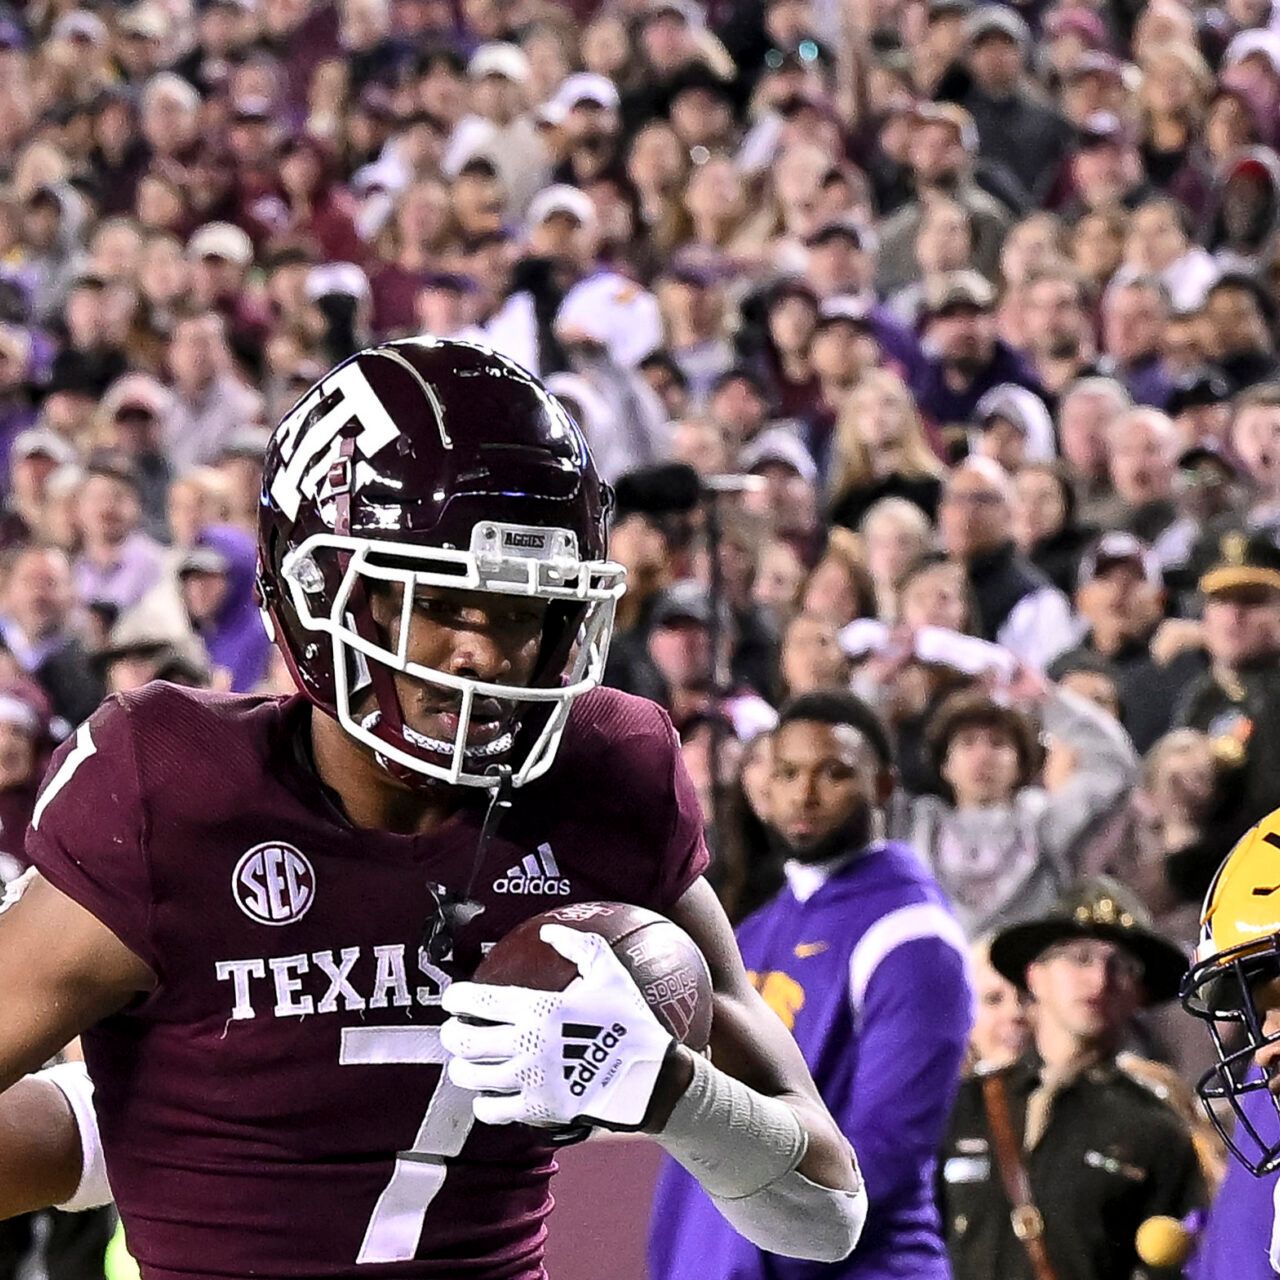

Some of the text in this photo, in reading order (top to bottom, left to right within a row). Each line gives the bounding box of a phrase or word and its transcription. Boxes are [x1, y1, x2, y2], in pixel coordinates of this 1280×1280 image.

[504, 532, 546, 549] AGGIES
[240, 847, 310, 920] SEC
[493, 875, 571, 896] adidas
[569, 1022, 628, 1097] adidas
[338, 1024, 477, 1265] 7
